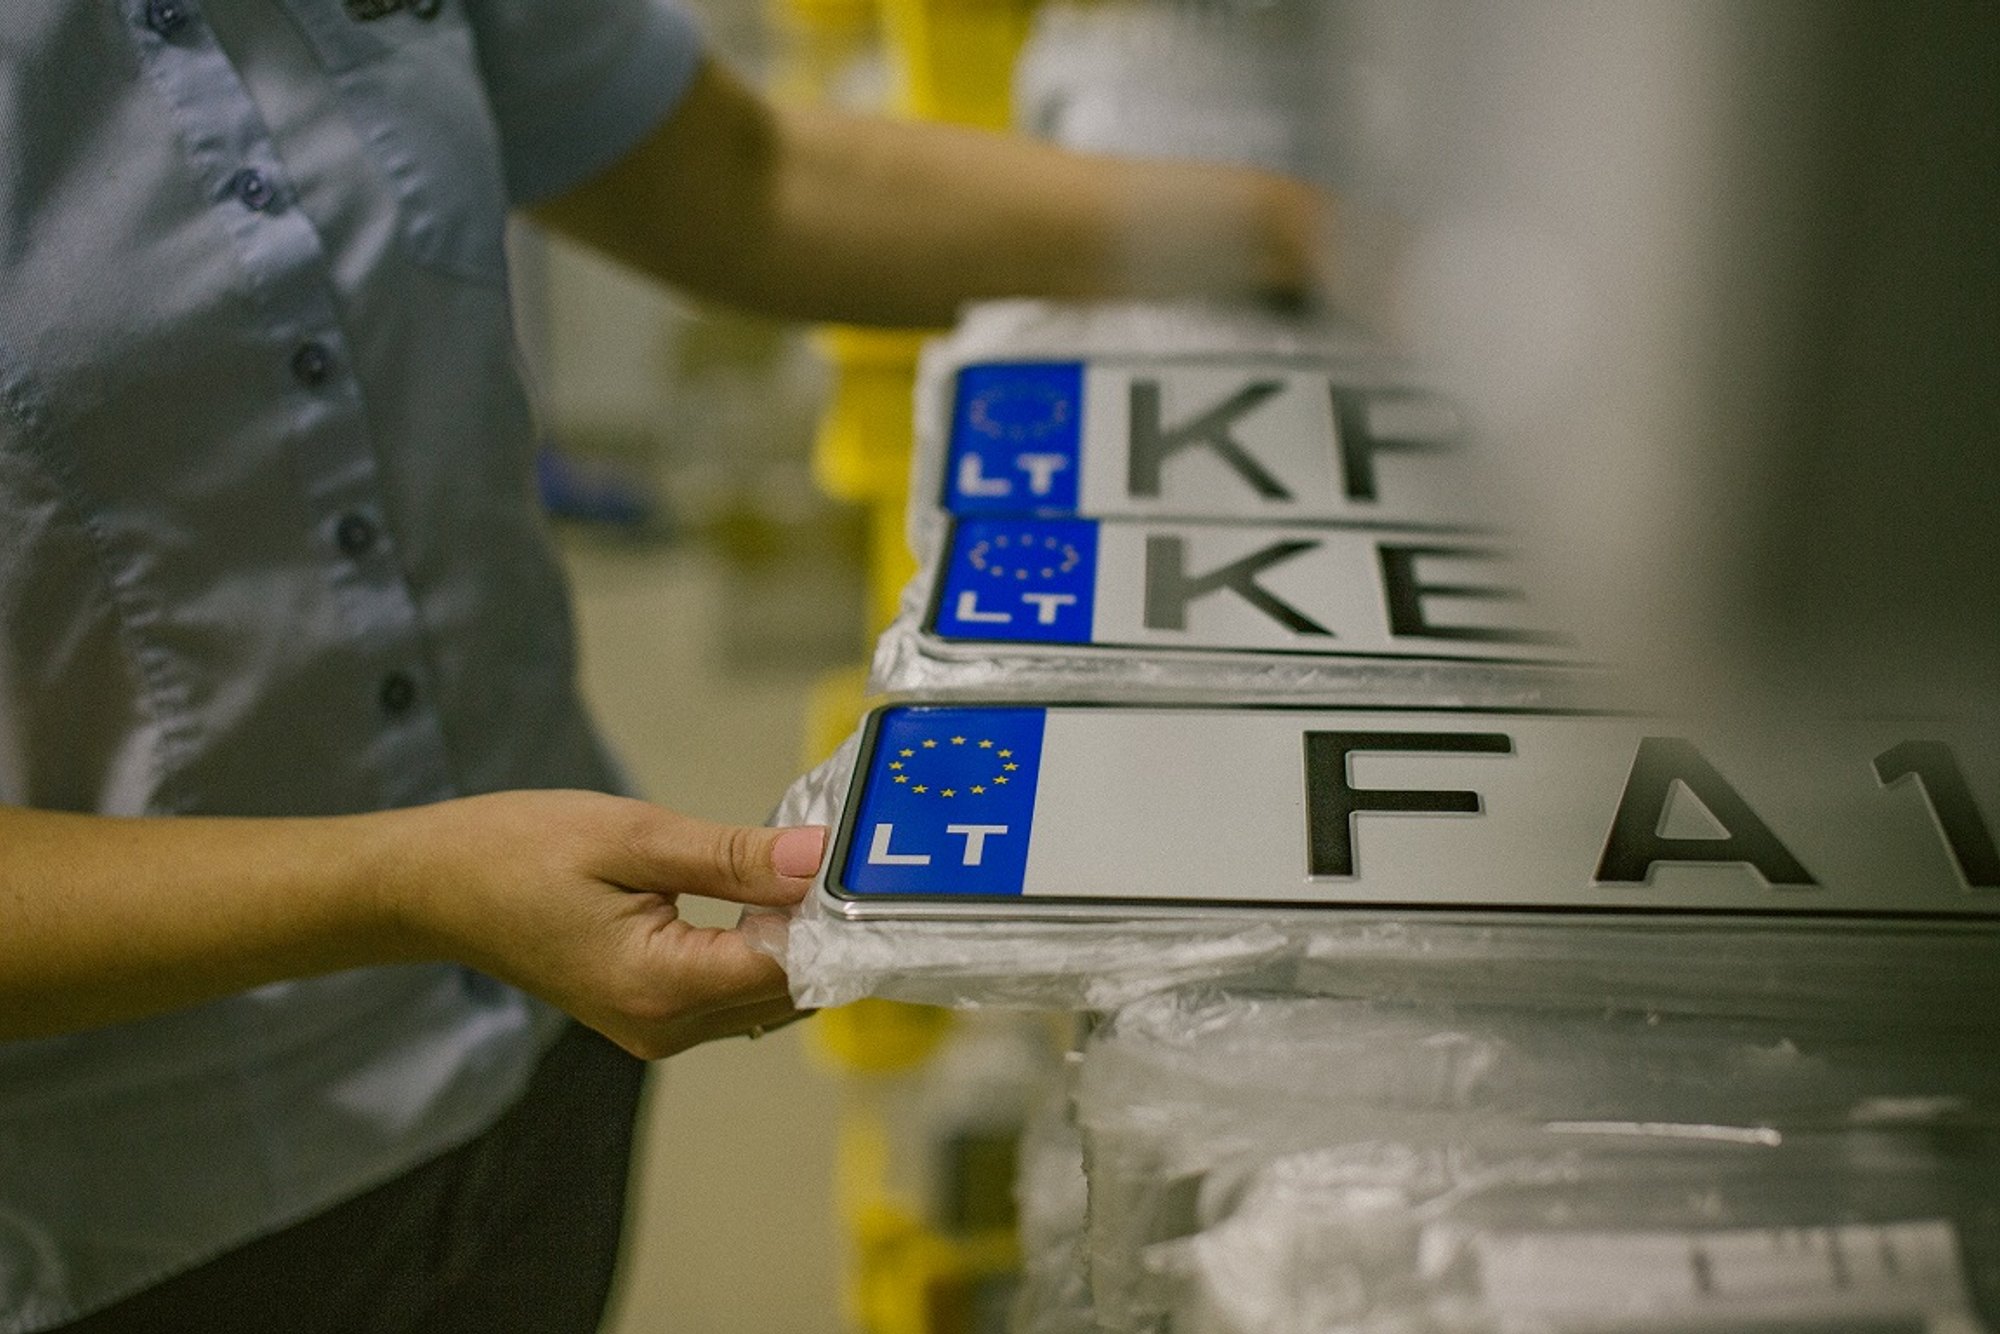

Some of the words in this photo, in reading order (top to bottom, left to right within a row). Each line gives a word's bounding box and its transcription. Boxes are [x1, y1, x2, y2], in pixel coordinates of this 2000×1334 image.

[956, 452, 1068, 497] LT
[954, 590, 1077, 625] LT
[1143, 533, 1574, 640] KE
[1302, 730, 2000, 888] FA1
[868, 823, 1008, 867] LT
